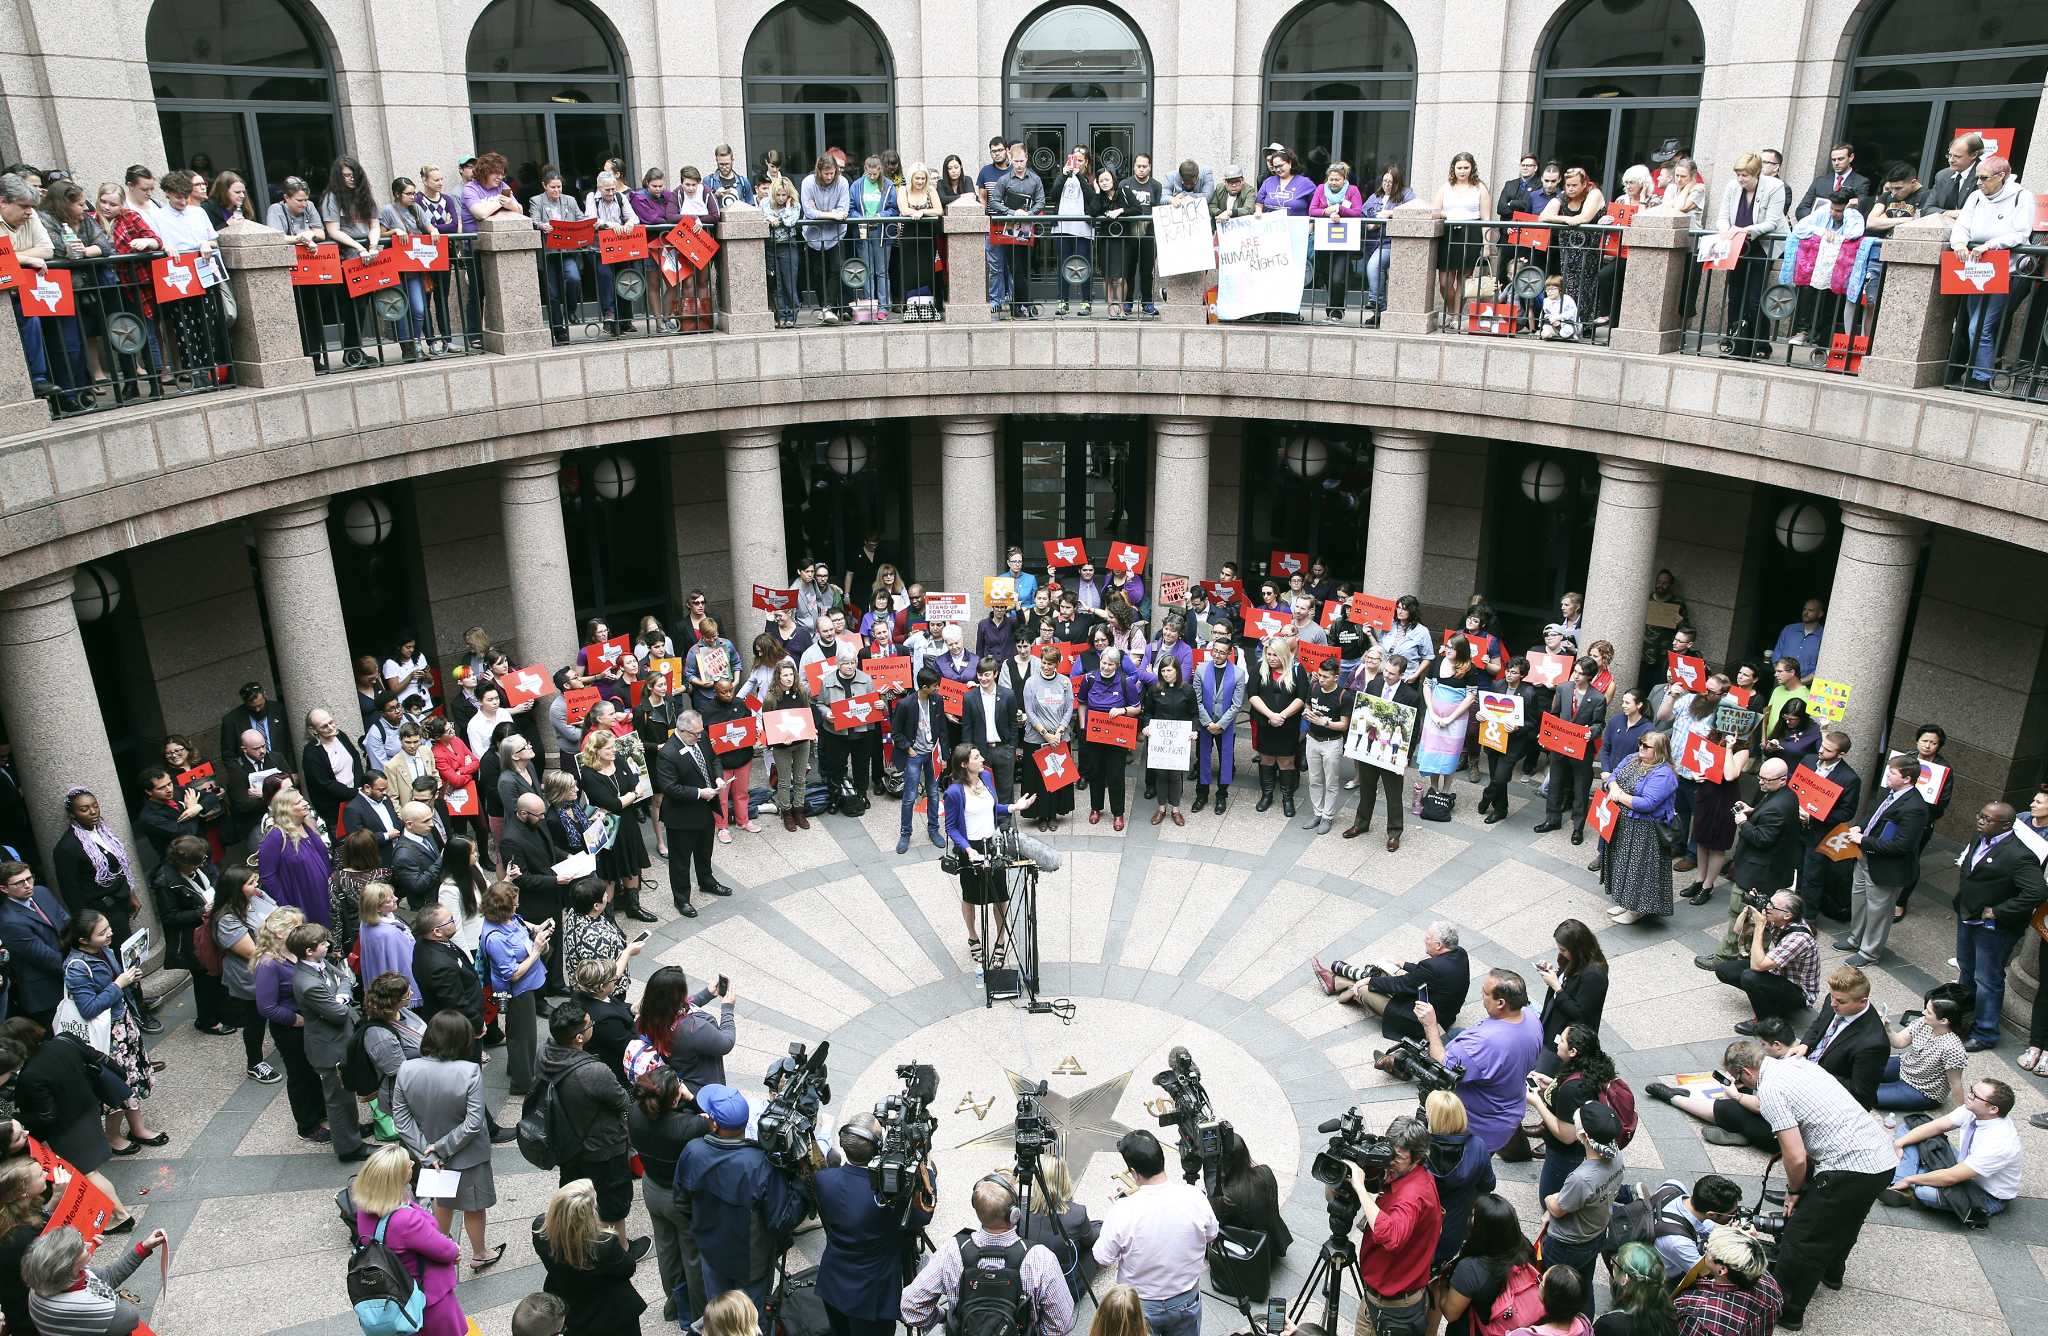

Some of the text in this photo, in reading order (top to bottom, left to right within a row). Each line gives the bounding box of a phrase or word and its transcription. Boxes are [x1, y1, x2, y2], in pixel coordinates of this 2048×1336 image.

[1240, 236, 1260, 249] ARE
[1219, 246, 1258, 266] HUMAN
[1249, 253, 1289, 272] RIGHTS
[1161, 580, 1184, 588] TRANS
[1722, 709, 1753, 719] TRANS
[1795, 773, 1834, 799] #YallMeansAll
[61, 1021, 89, 1032] WHOLE
